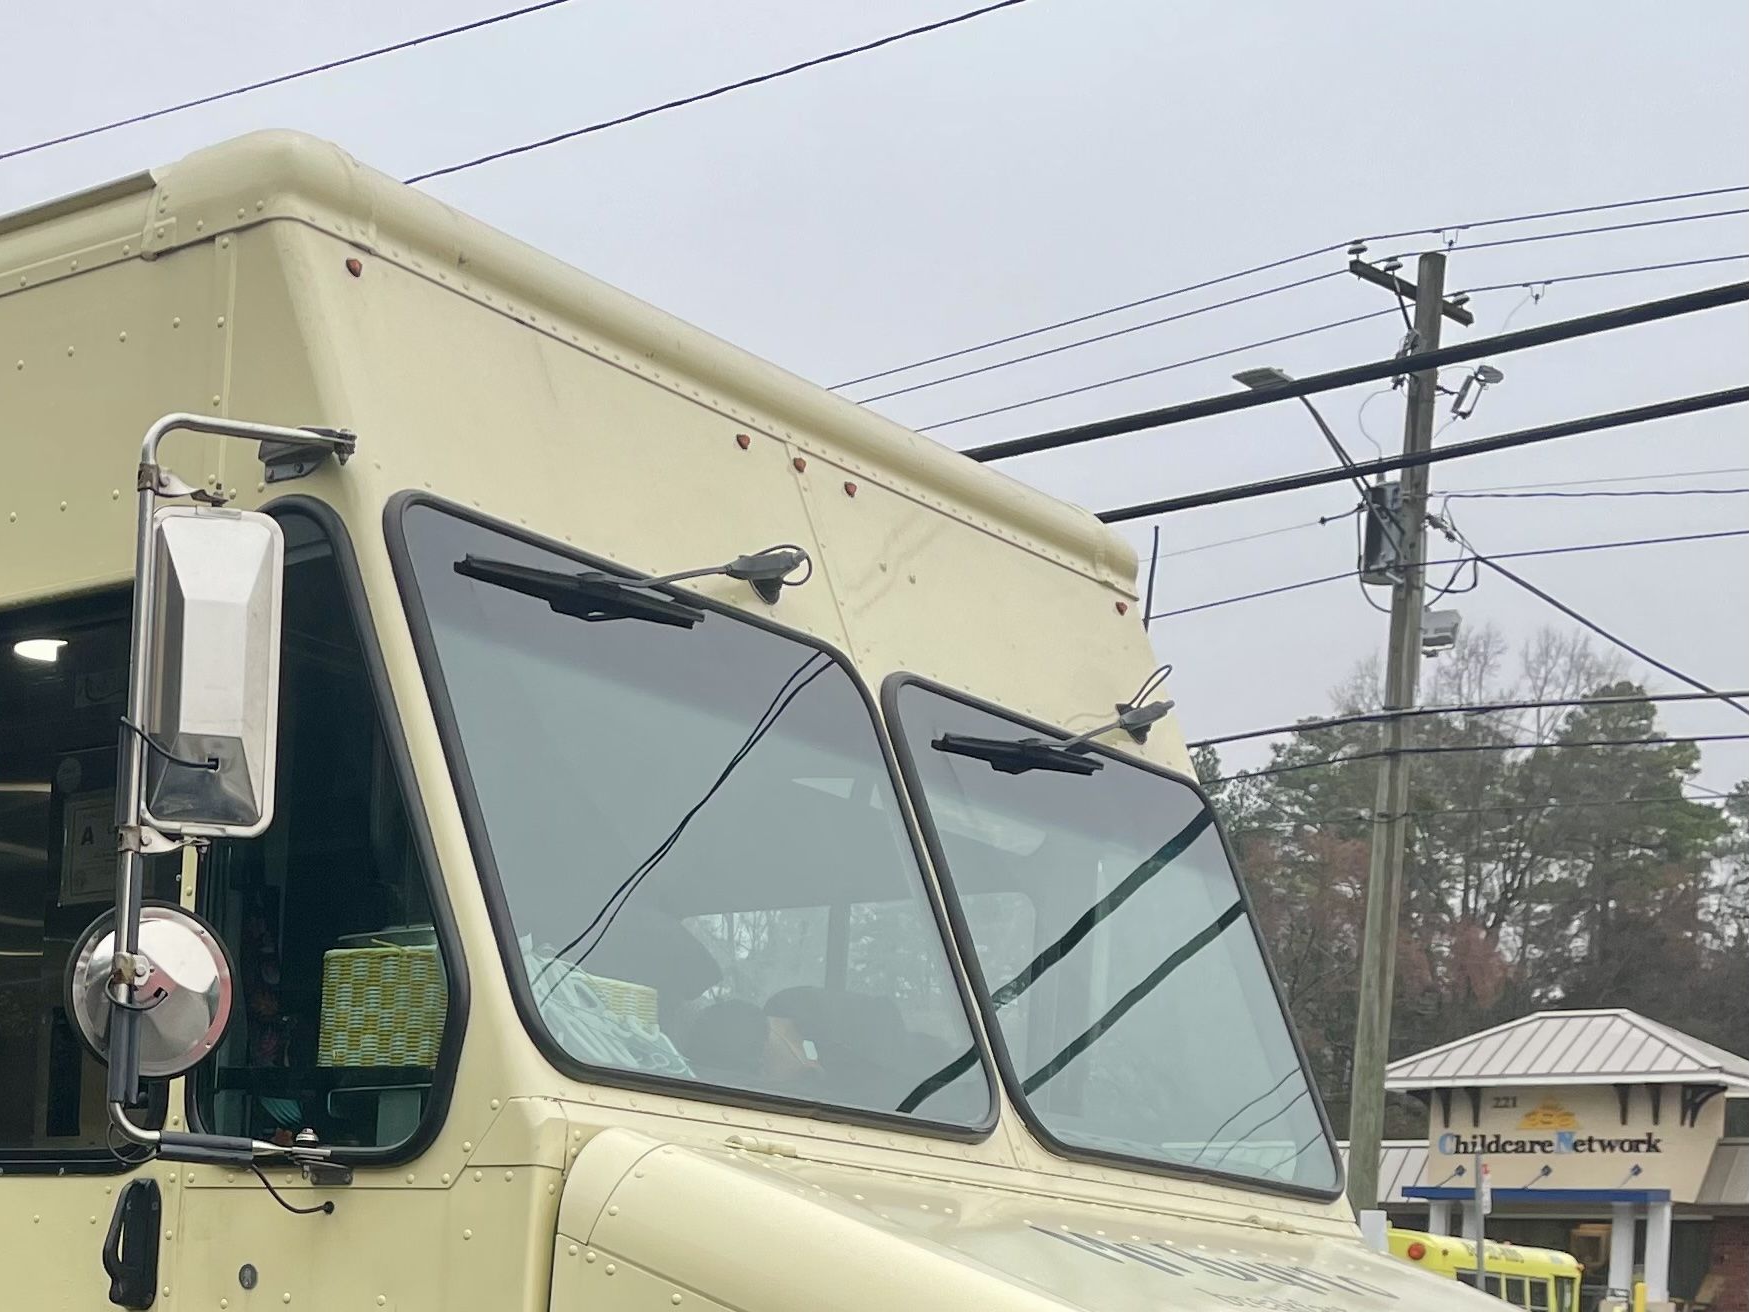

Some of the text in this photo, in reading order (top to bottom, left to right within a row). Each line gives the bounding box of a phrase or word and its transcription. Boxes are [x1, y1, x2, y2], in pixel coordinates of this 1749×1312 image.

[81, 825, 95, 846] A
[1493, 1096, 1518, 1109] 221
[1438, 1131, 1662, 1155] Childcare Network
